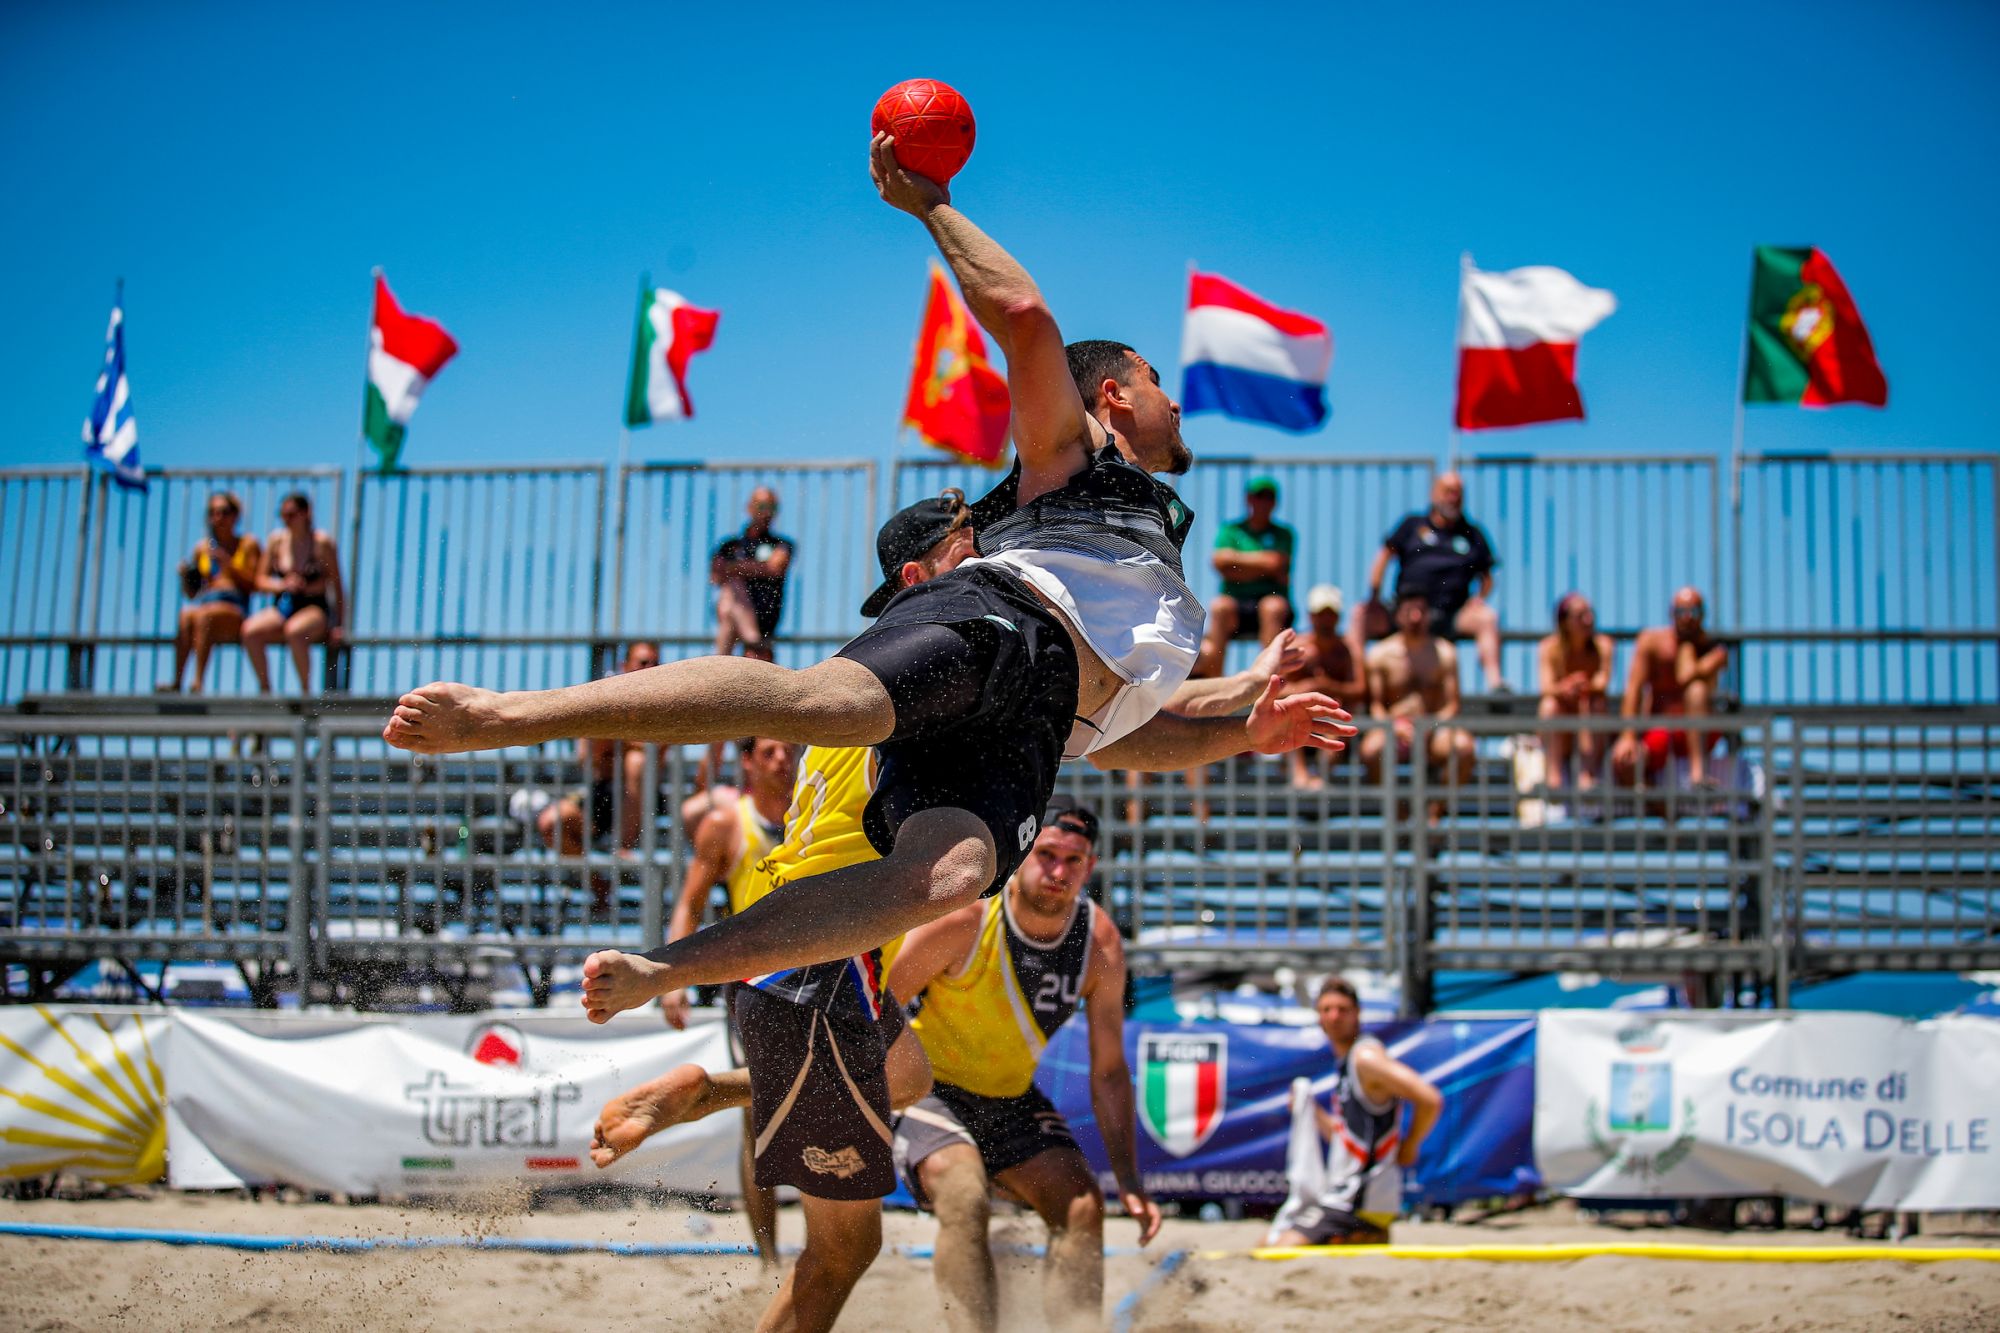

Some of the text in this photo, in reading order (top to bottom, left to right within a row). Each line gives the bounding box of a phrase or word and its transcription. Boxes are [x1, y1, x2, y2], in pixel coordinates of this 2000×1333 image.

[1018, 814, 1037, 851] 8
[1729, 1067, 1907, 1101] Comune di
[405, 1070, 582, 1148] trial
